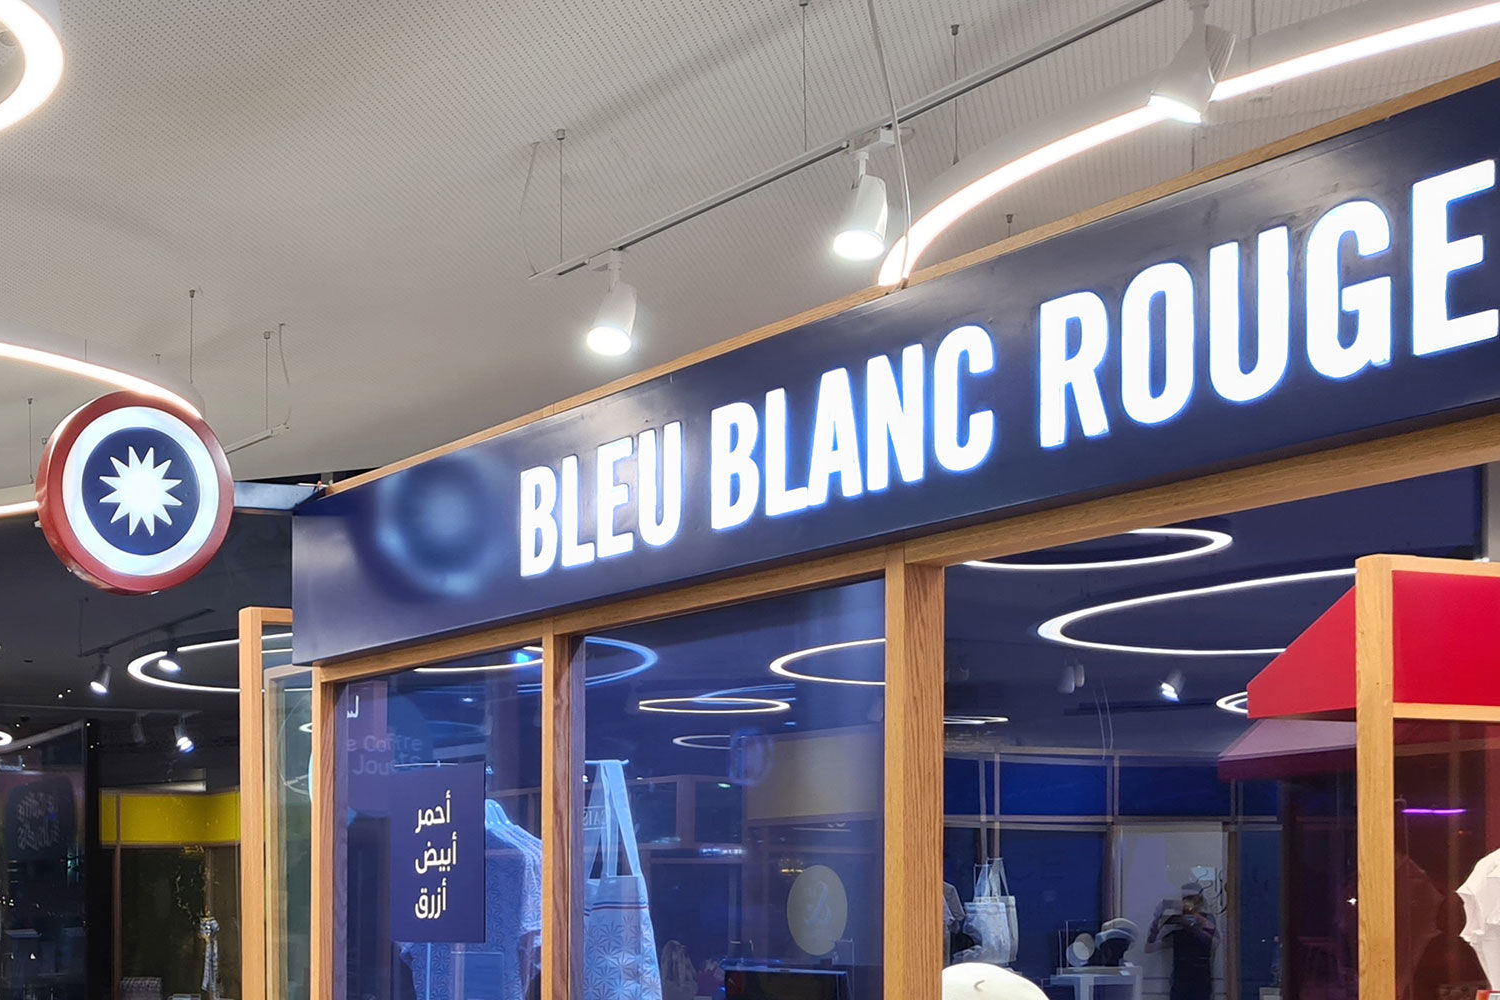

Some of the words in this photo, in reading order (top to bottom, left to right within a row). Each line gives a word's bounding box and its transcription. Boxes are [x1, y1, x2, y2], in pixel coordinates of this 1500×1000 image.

[519, 421, 682, 578] BLEU
[710, 325, 995, 531] BLANC
[1037, 158, 1500, 449] ROUGE
[414, 788, 452, 834] أحمر
[414, 830, 457, 875] أبيض
[414, 876, 448, 920] أزرق
